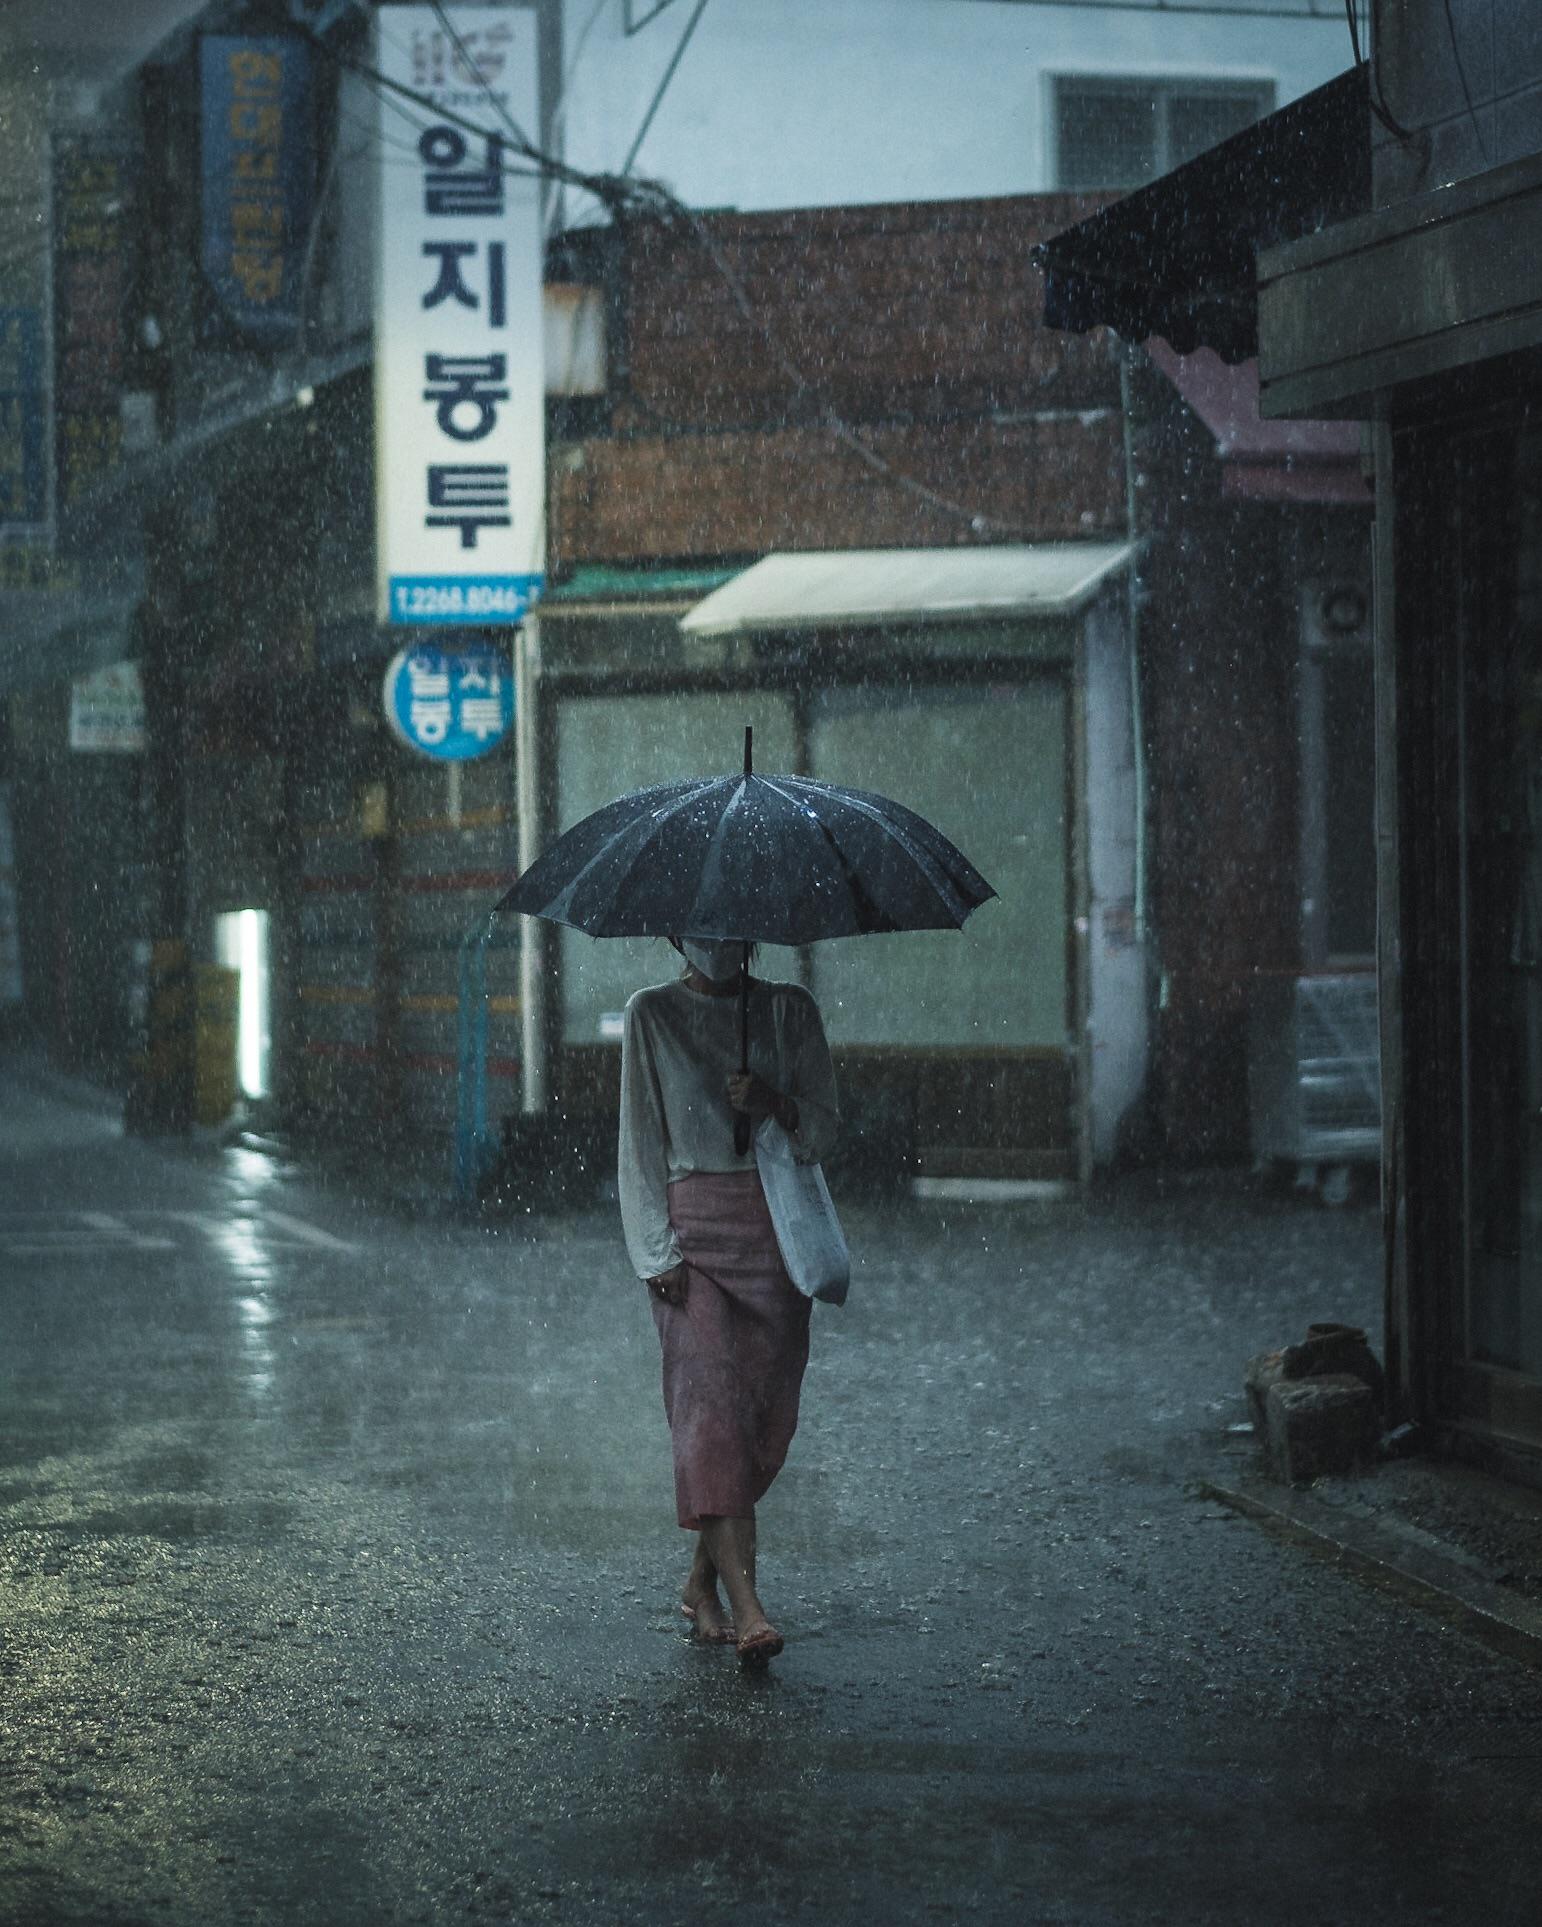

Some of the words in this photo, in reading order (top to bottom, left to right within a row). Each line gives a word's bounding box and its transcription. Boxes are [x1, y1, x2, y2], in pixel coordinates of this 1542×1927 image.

[419, 125, 512, 549] 일지봉투
[408, 656, 500, 696] 일지
[411, 698, 504, 743] 봉투
